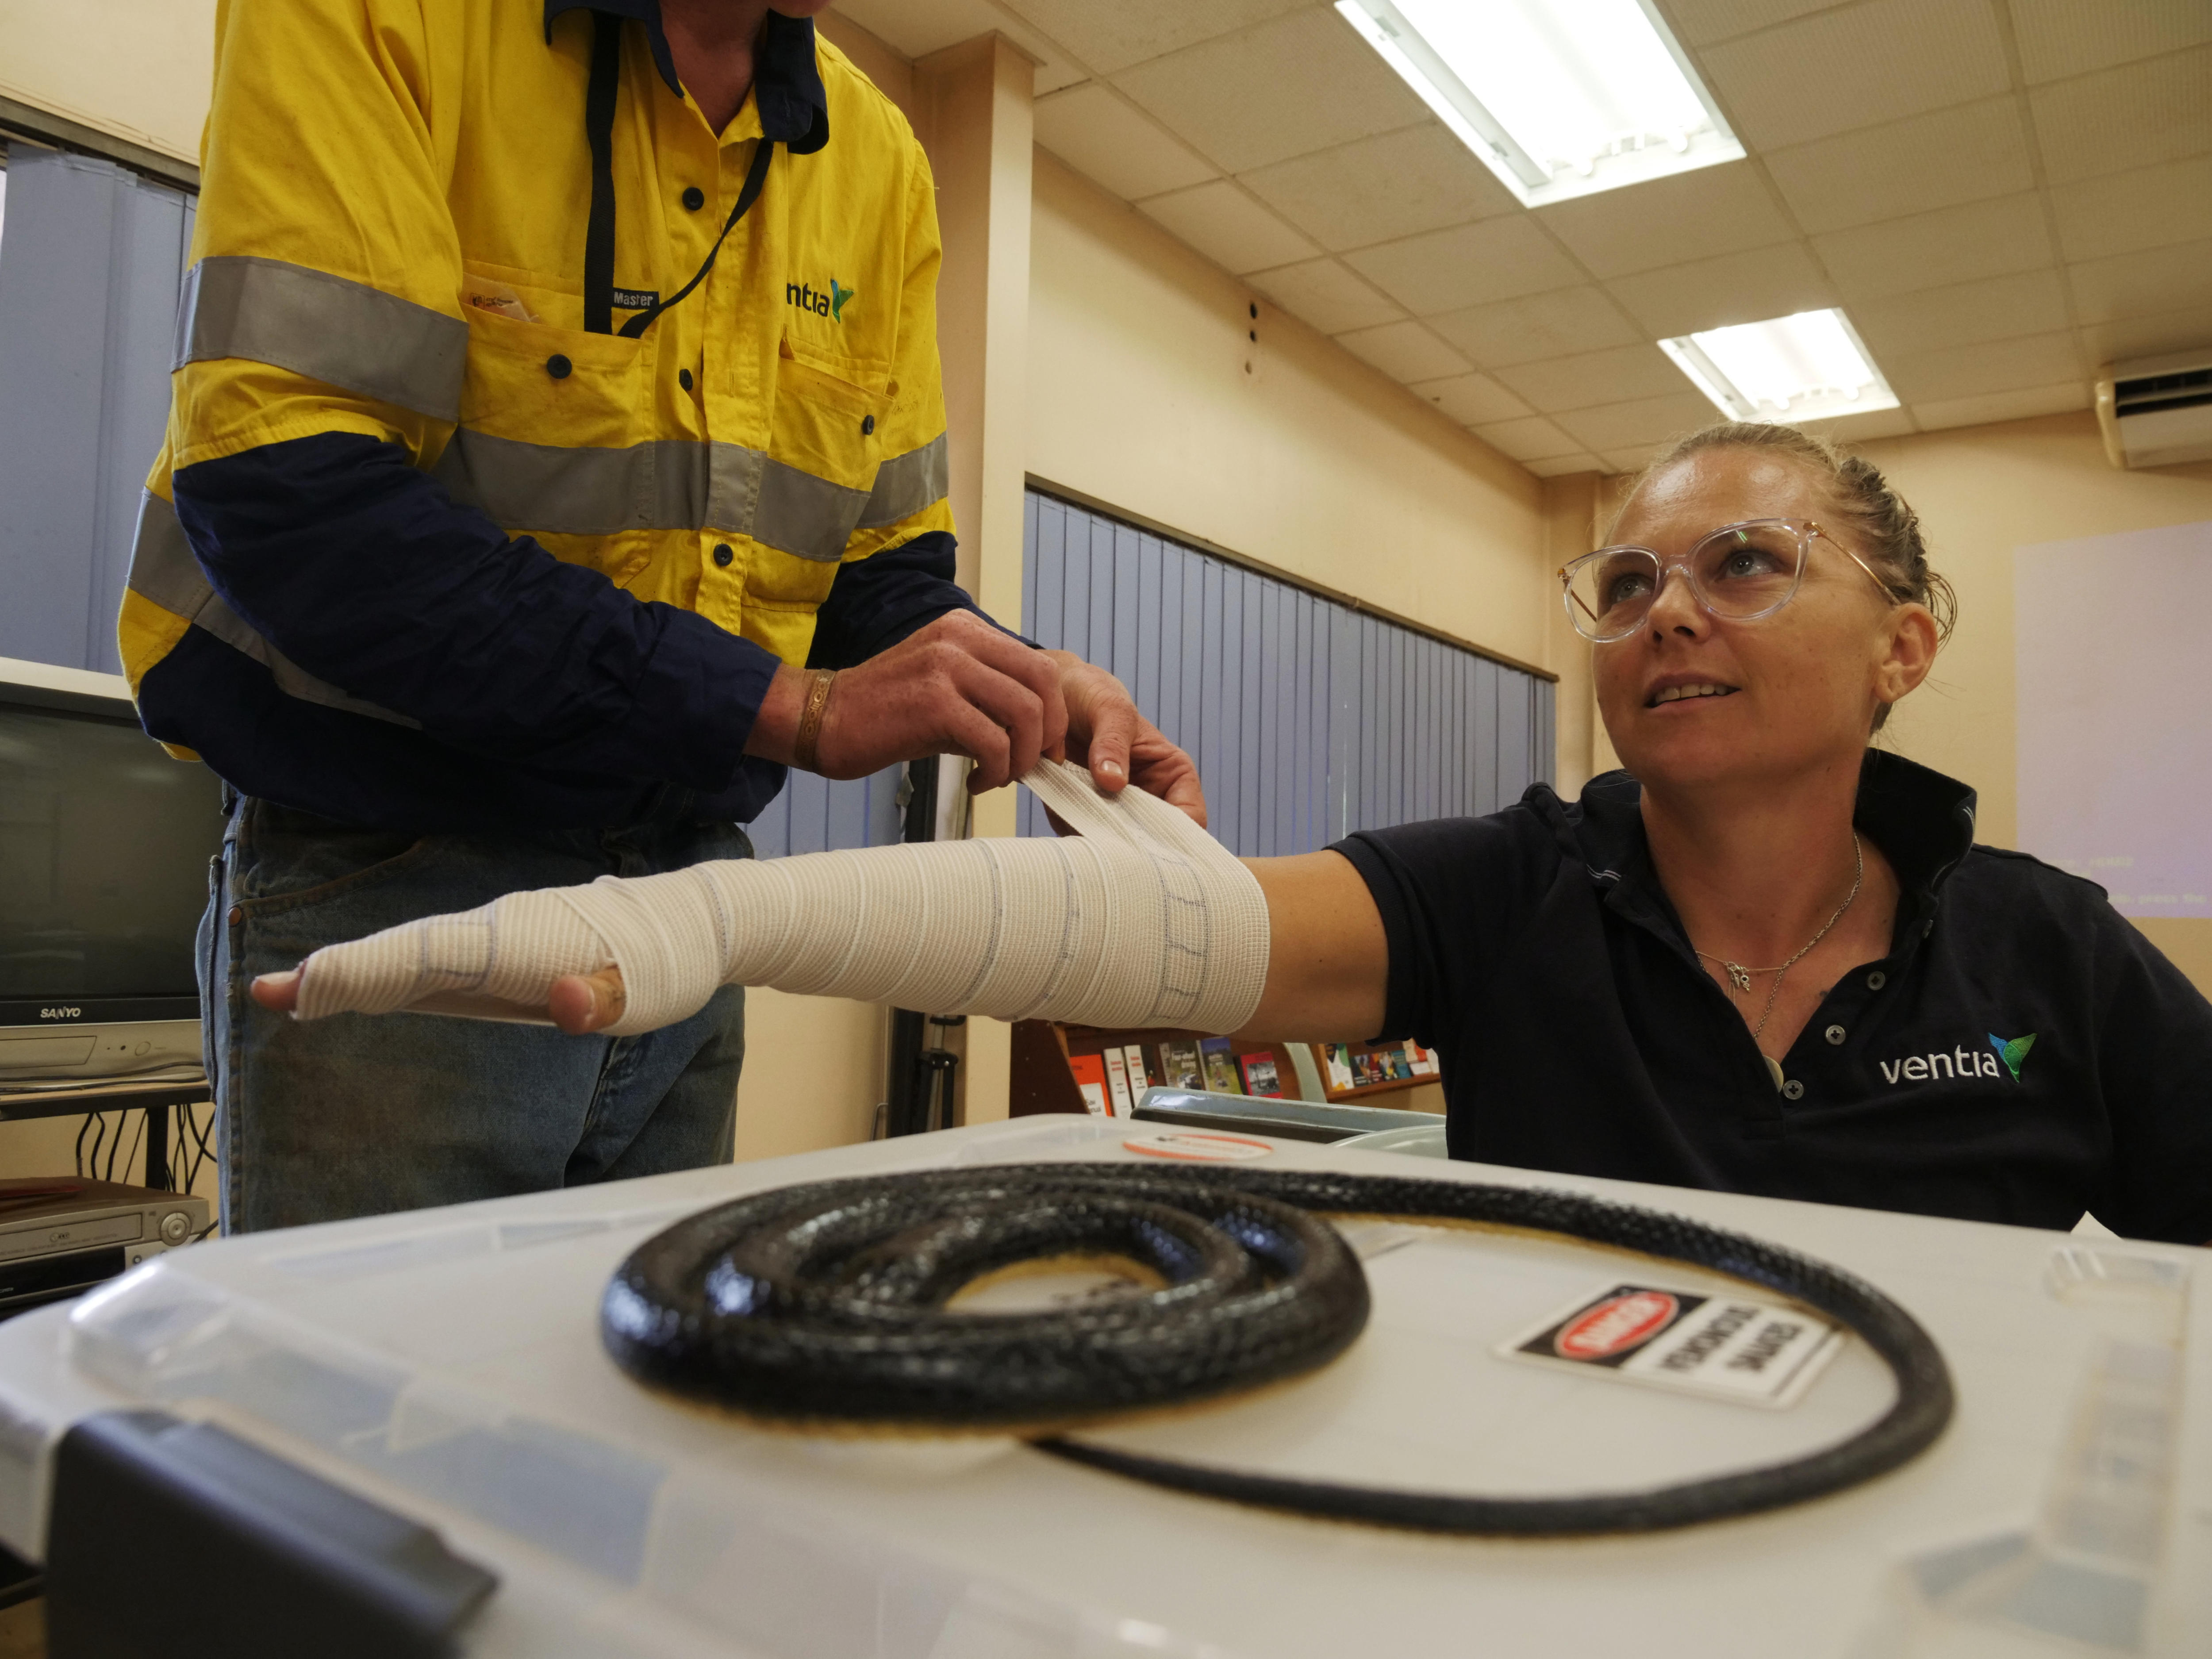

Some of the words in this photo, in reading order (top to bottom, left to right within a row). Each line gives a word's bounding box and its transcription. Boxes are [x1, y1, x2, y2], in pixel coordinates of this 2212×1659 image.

[613, 291, 654, 307] Master
[786, 283, 830, 317] ntia
[40, 1006, 81, 1019] SANYO
[1880, 1044, 2000, 1084] ventia
